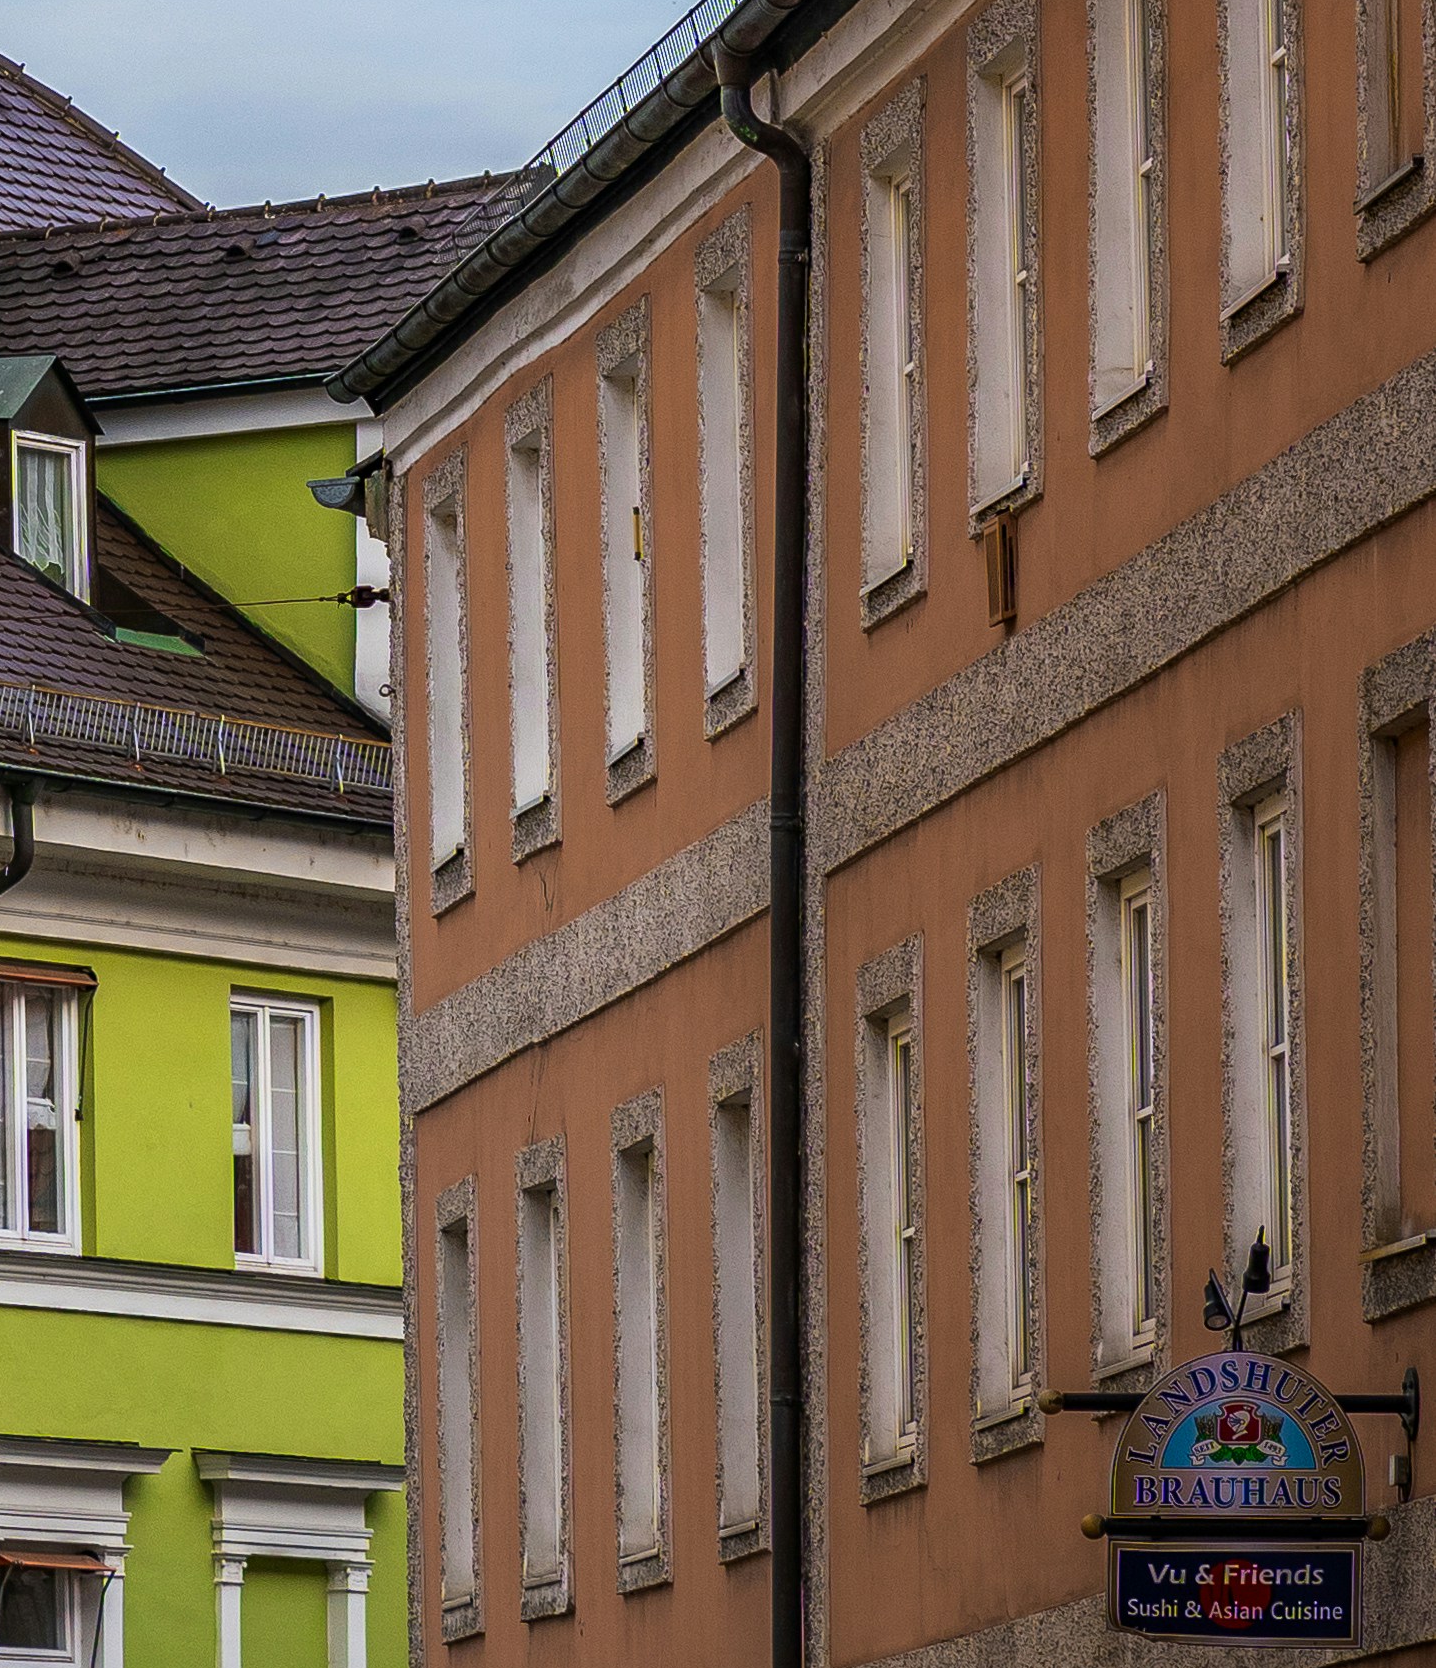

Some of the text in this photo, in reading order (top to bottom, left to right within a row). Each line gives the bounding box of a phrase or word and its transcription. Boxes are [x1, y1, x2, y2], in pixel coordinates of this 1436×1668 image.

[1126, 1360, 1350, 1468] LANDSHUTER
[1134, 1475, 1342, 1508] BRAUHAUS
[1148, 1564, 1325, 1586] Vu & Friends
[1127, 1598, 1343, 1620] Sushi & Asian Cuisine
